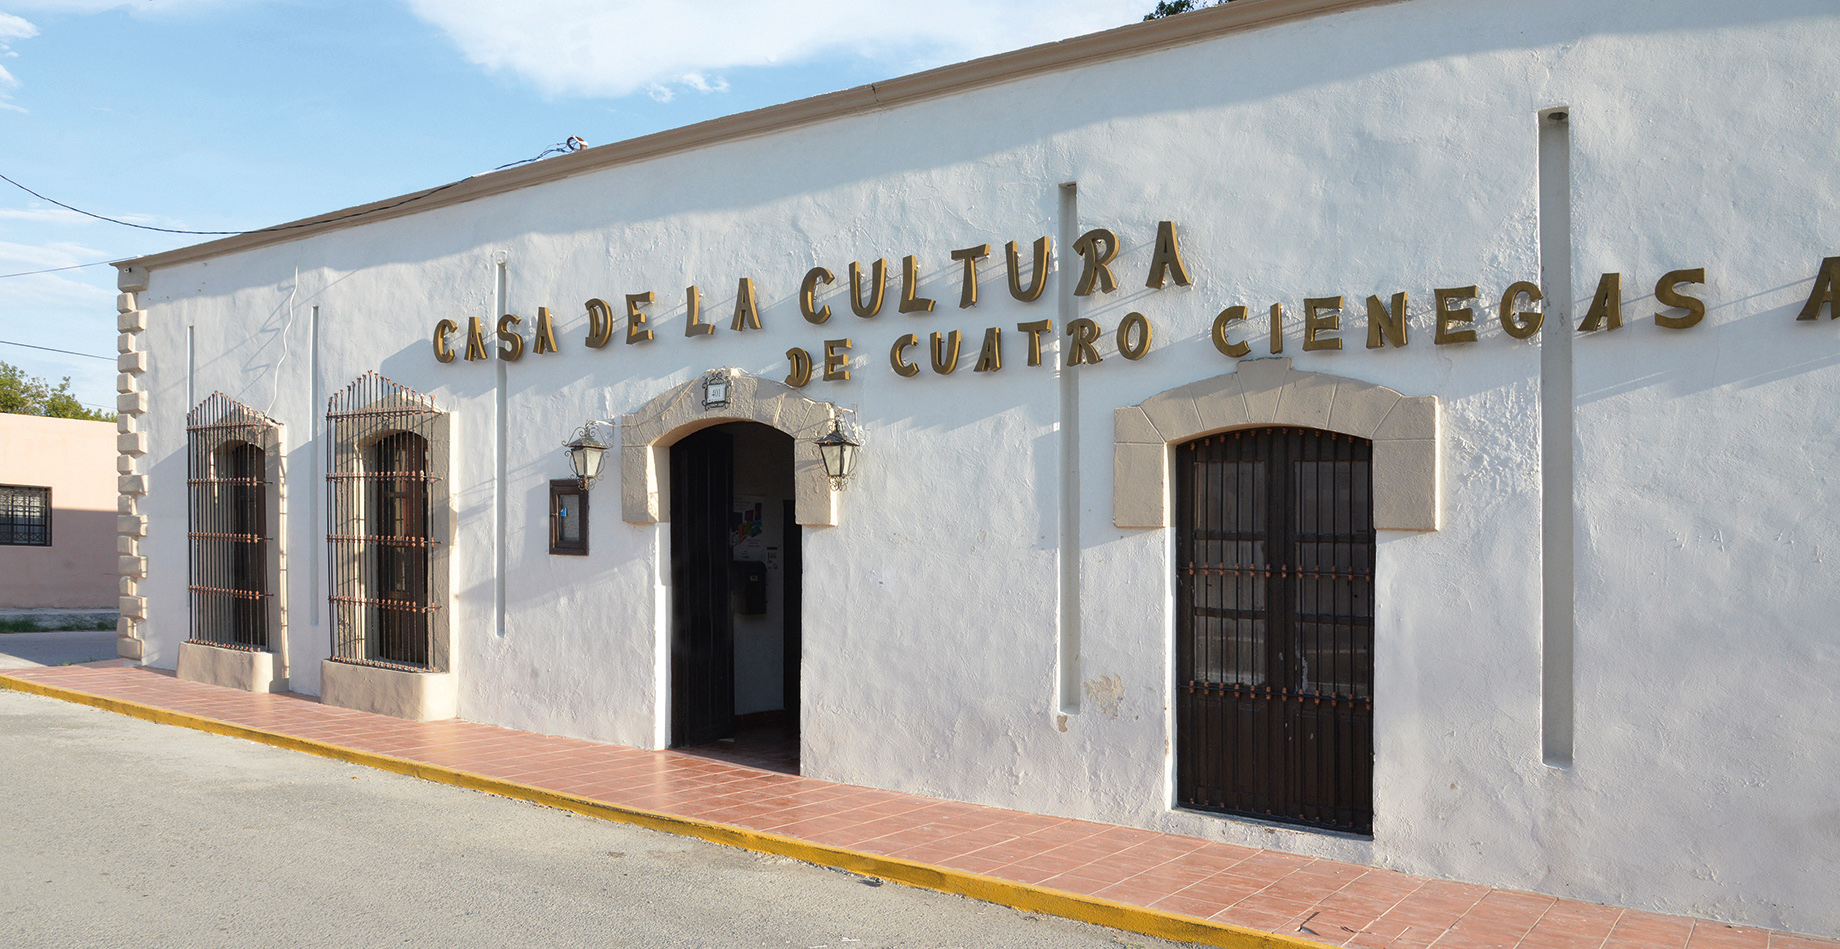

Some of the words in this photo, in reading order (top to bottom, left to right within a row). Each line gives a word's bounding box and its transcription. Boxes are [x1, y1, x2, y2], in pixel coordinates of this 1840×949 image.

[433, 307, 557, 363] CASA
[585, 291, 655, 349] DE
[685, 277, 763, 338] LA
[800, 221, 1191, 325] CULTURA
[785, 338, 852, 388] DE
[890, 311, 1152, 378] CUATRO
[1212, 267, 1705, 358] CIENEGAS
